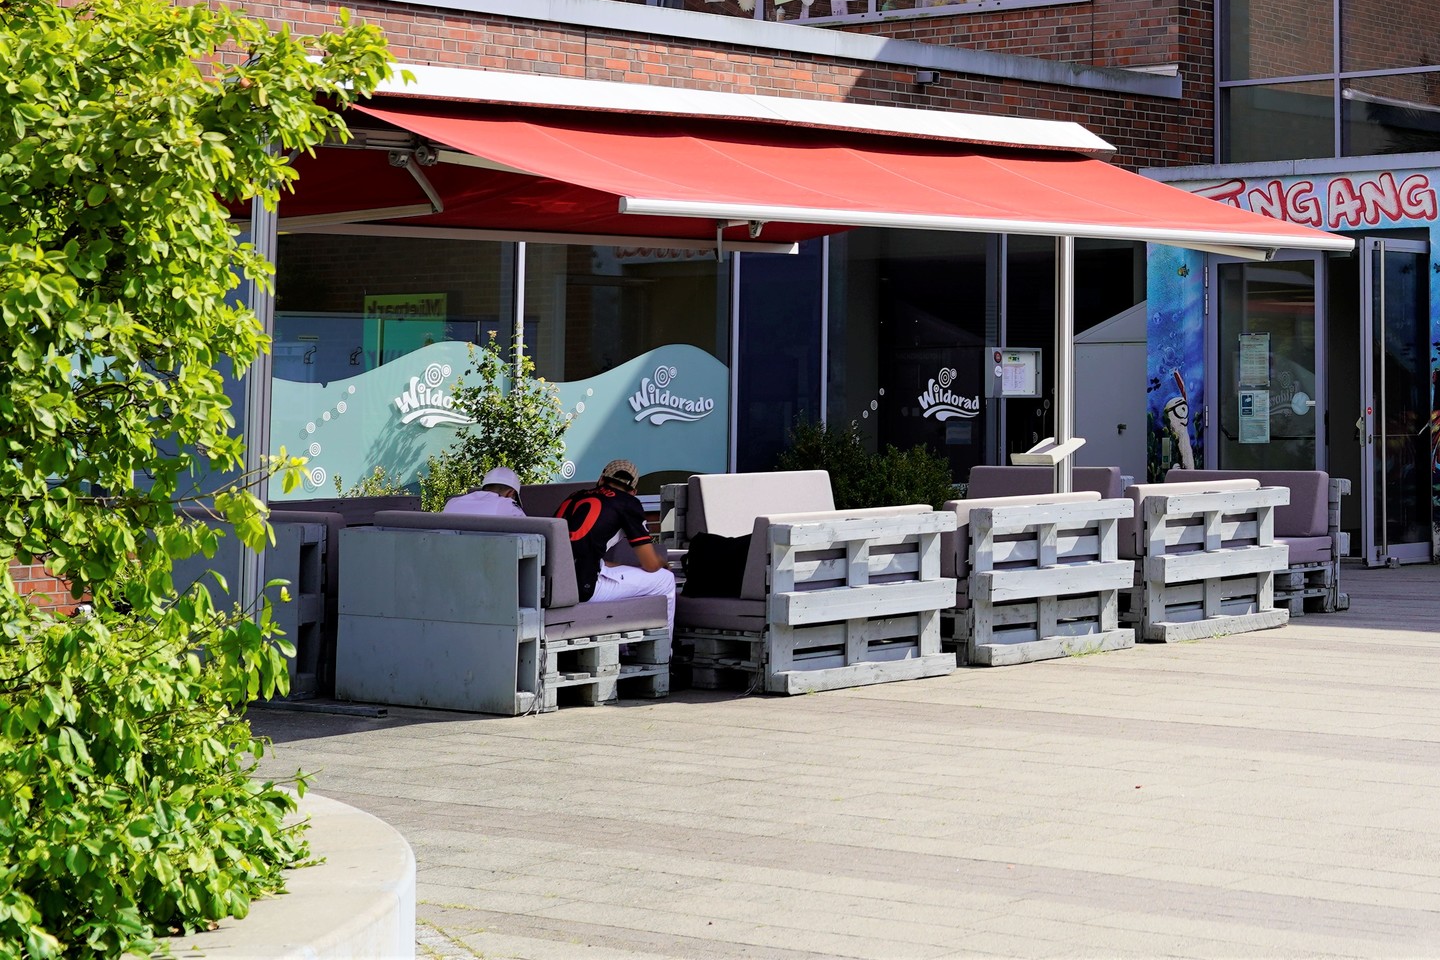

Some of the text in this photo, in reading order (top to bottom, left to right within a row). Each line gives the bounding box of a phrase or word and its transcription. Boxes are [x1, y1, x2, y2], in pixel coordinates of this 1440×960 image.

[1191, 172, 1438, 229] NGANG
[395, 376, 464, 413] Wildo
[628, 377, 714, 412] Wildorado
